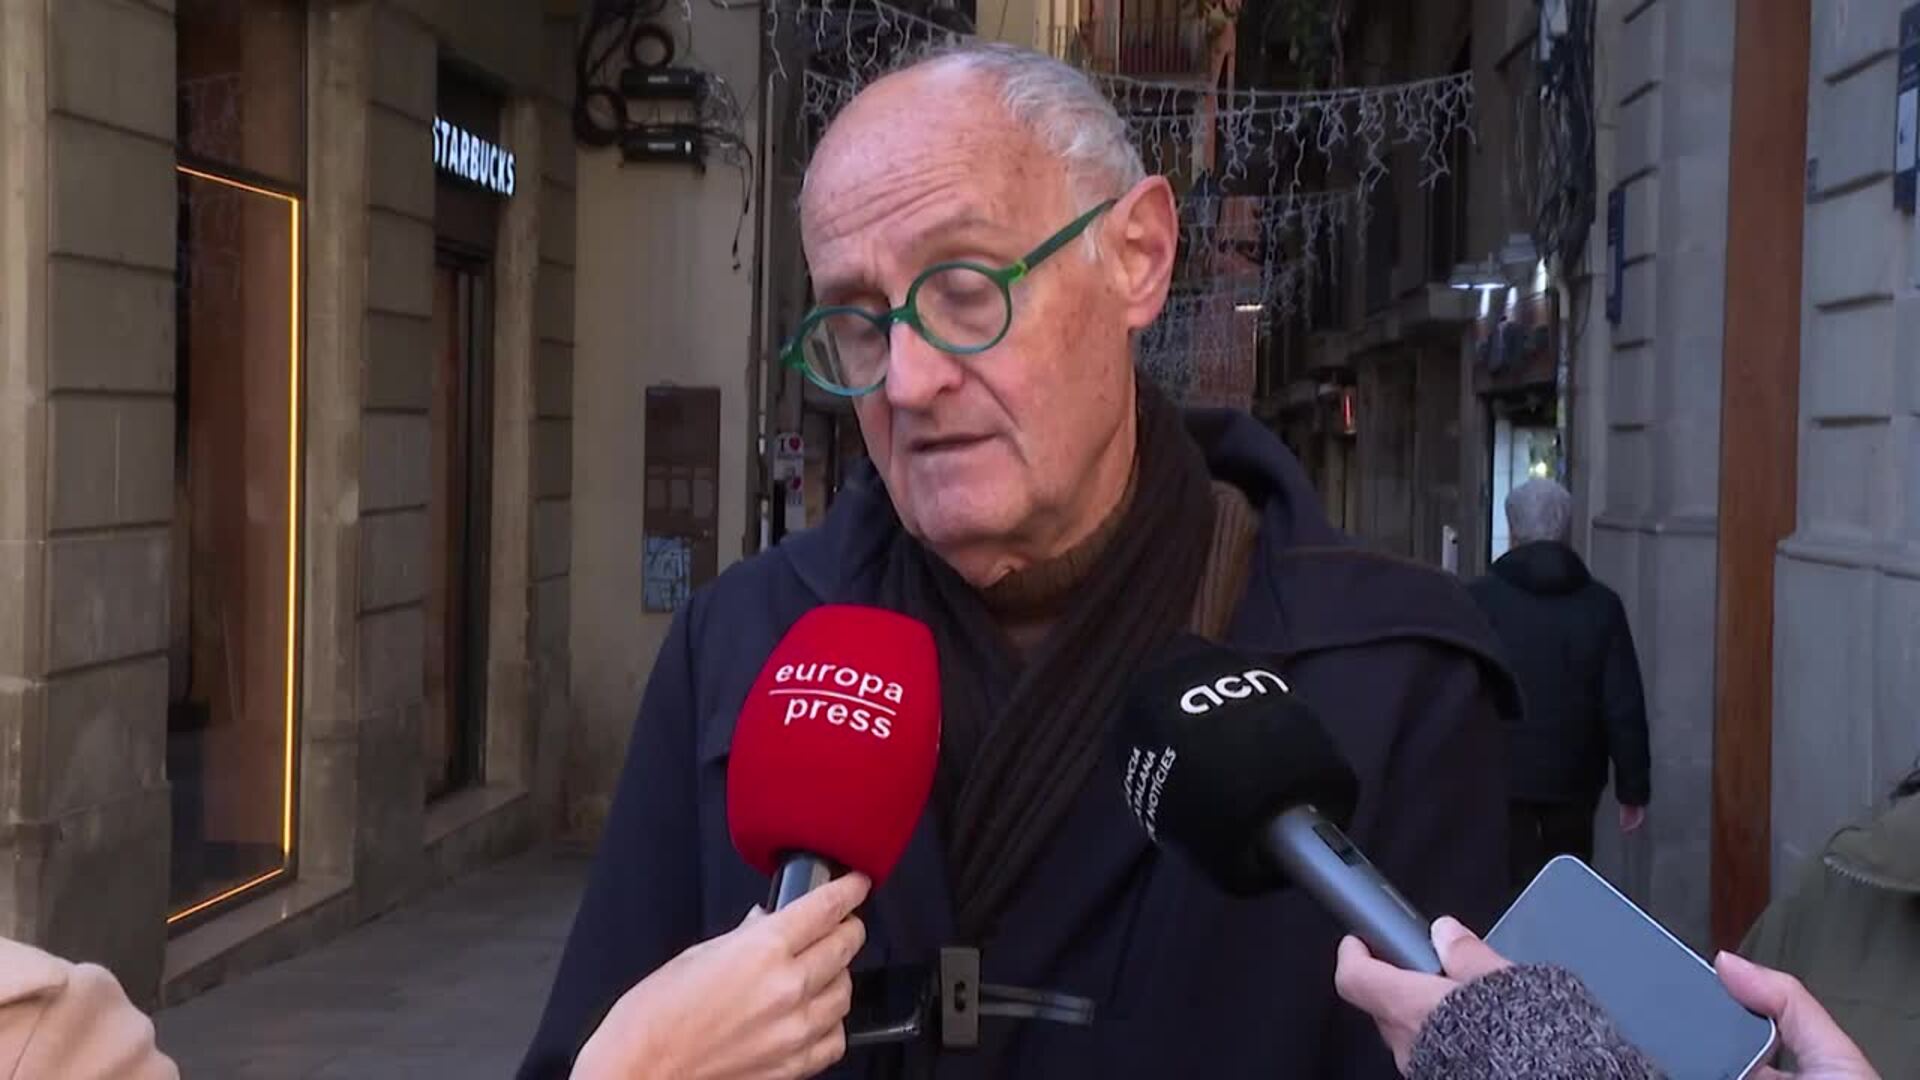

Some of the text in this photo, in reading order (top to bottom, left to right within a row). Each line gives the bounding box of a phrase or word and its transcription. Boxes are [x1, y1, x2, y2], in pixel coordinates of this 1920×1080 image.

[775, 663, 904, 703] europa
[1180, 670, 1290, 714] acn
[784, 698, 892, 739] press
